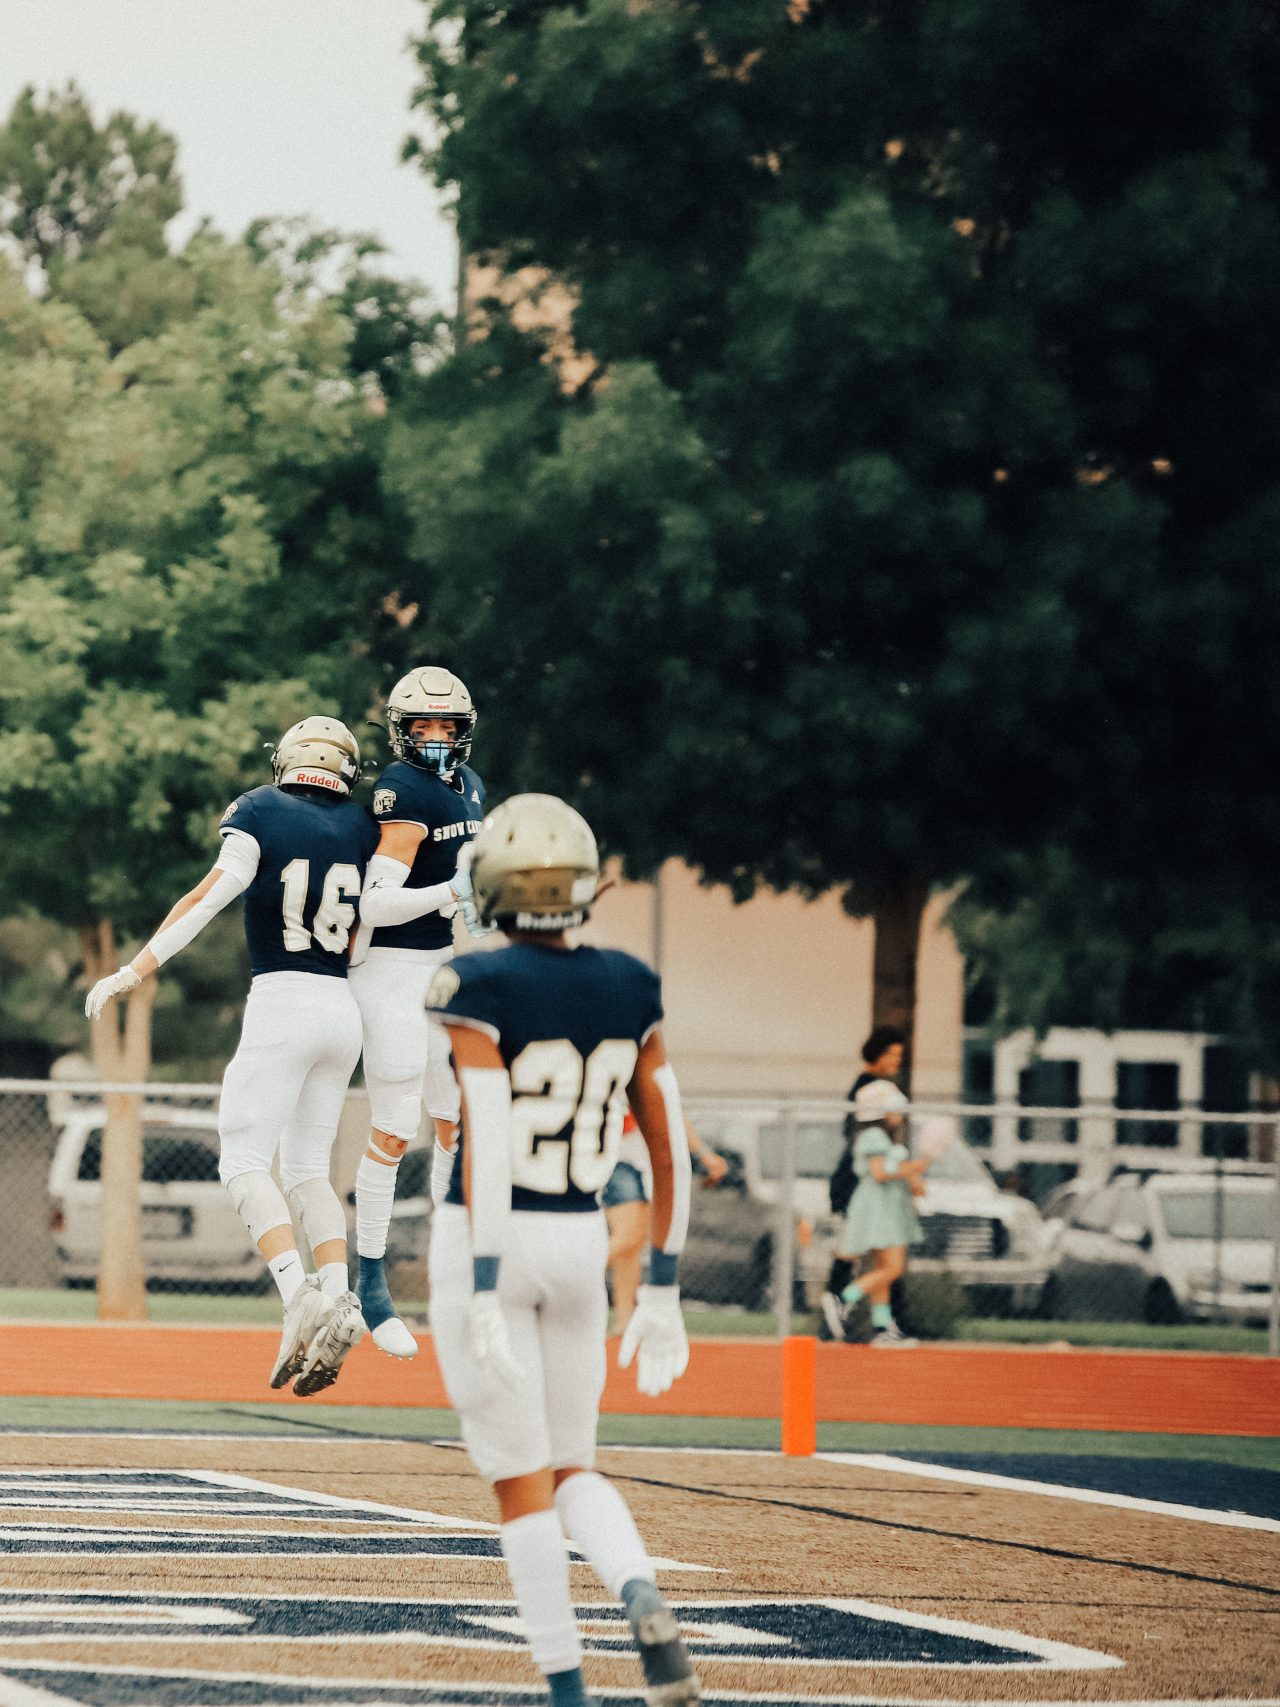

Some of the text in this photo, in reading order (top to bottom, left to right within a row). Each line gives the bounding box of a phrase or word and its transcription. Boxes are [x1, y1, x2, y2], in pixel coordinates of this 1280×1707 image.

[297, 773, 339, 790] Riddell
[433, 821, 465, 842] SNOW
[280, 858, 361, 954] 16
[510, 1038, 639, 1194] 20
